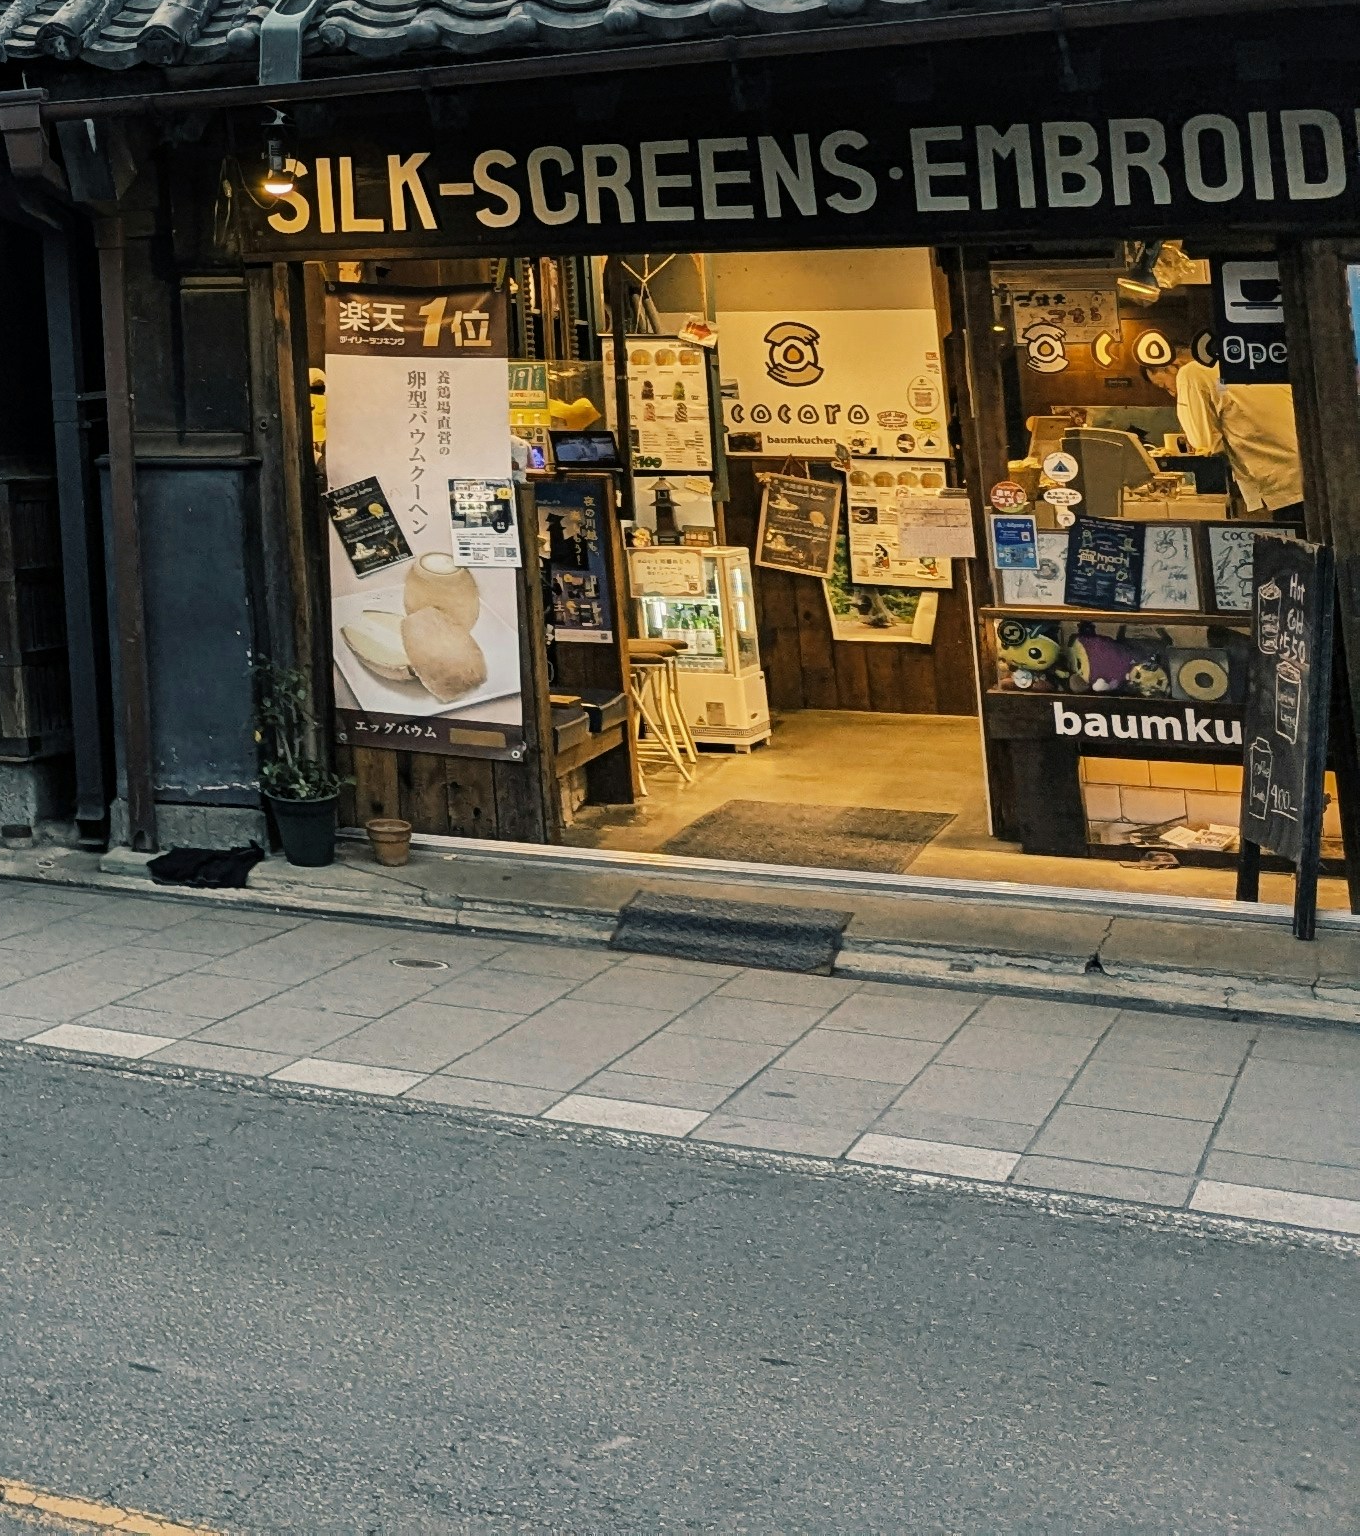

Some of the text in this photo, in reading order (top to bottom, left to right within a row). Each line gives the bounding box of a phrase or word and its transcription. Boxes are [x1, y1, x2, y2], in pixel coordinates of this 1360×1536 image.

[908, 107, 1360, 212] EMBROID
[339, 296, 493, 348] 楽天 1位
[730, 403, 870, 425] cocoro
[406, 370, 429, 536] 卵型バウムクーヘン
[766, 435, 837, 446] baumkuchen
[354, 720, 438, 739] エッグバウム
[1052, 701, 1243, 745] baumku
